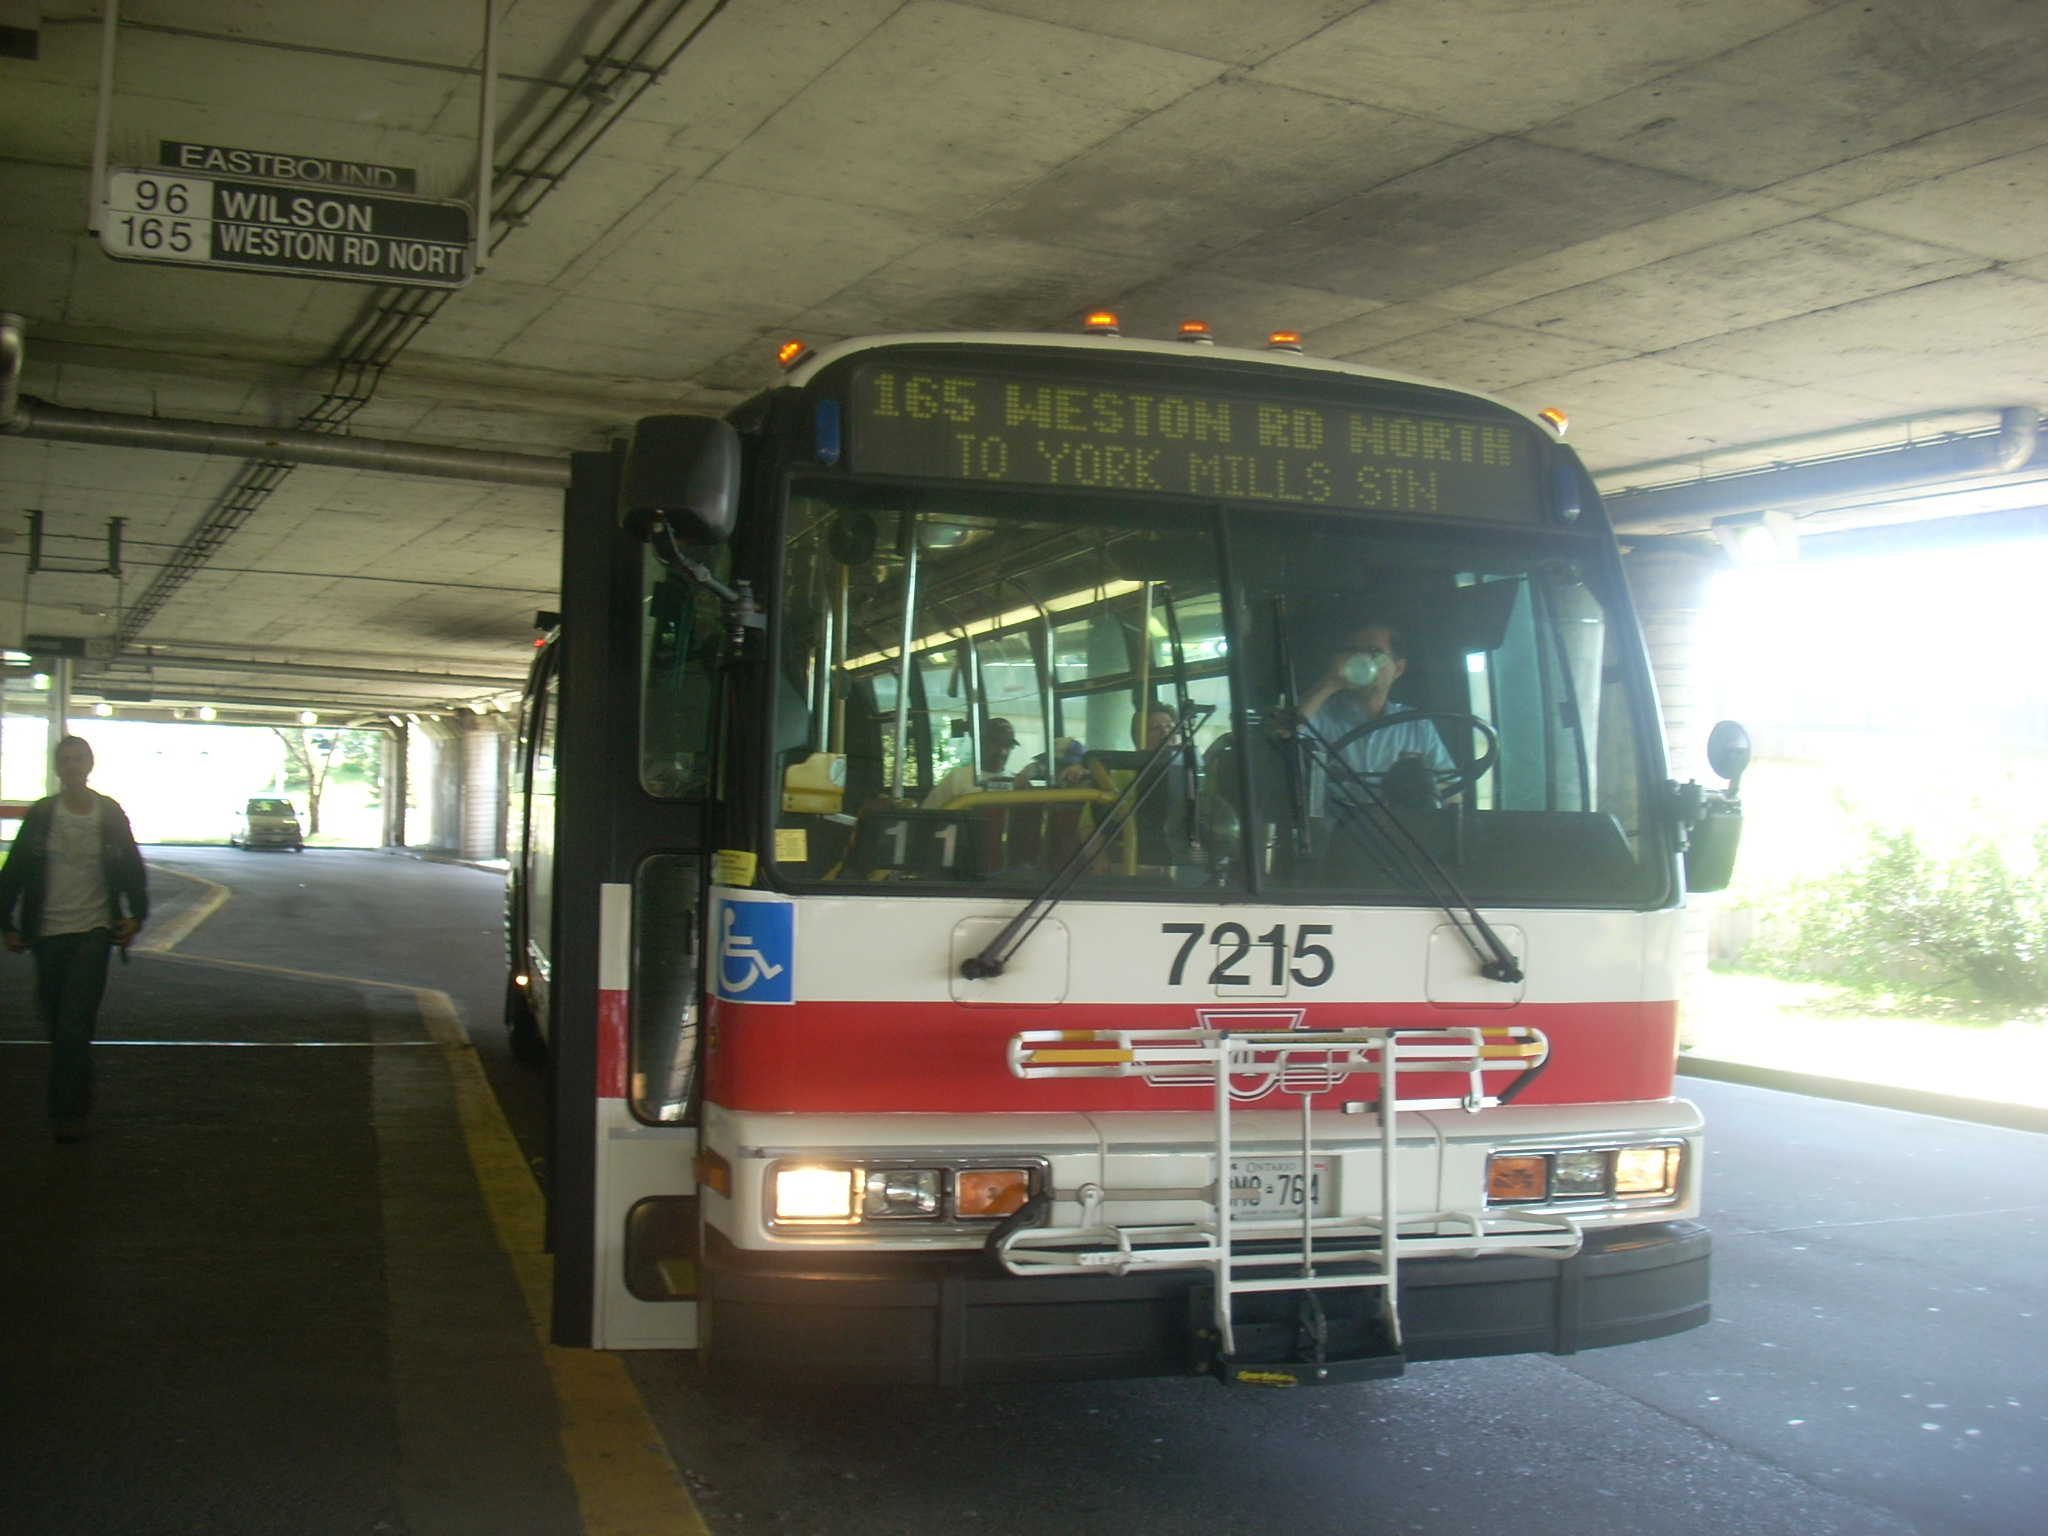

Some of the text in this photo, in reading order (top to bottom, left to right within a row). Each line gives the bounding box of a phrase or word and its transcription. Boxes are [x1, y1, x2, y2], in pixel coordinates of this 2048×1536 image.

[179, 144, 396, 190] EASTBOUND
[136, 180, 189, 214] 96
[221, 190, 372, 233] WILSON
[121, 215, 192, 253] 165
[219, 224, 335, 265] WESTON
[343, 237, 380, 267] RD
[873, 373, 1511, 466] 165 WESTON RD NORTH
[955, 432, 1438, 511] TO YORK MILLS STN
[1161, 921, 1335, 988] 7215
